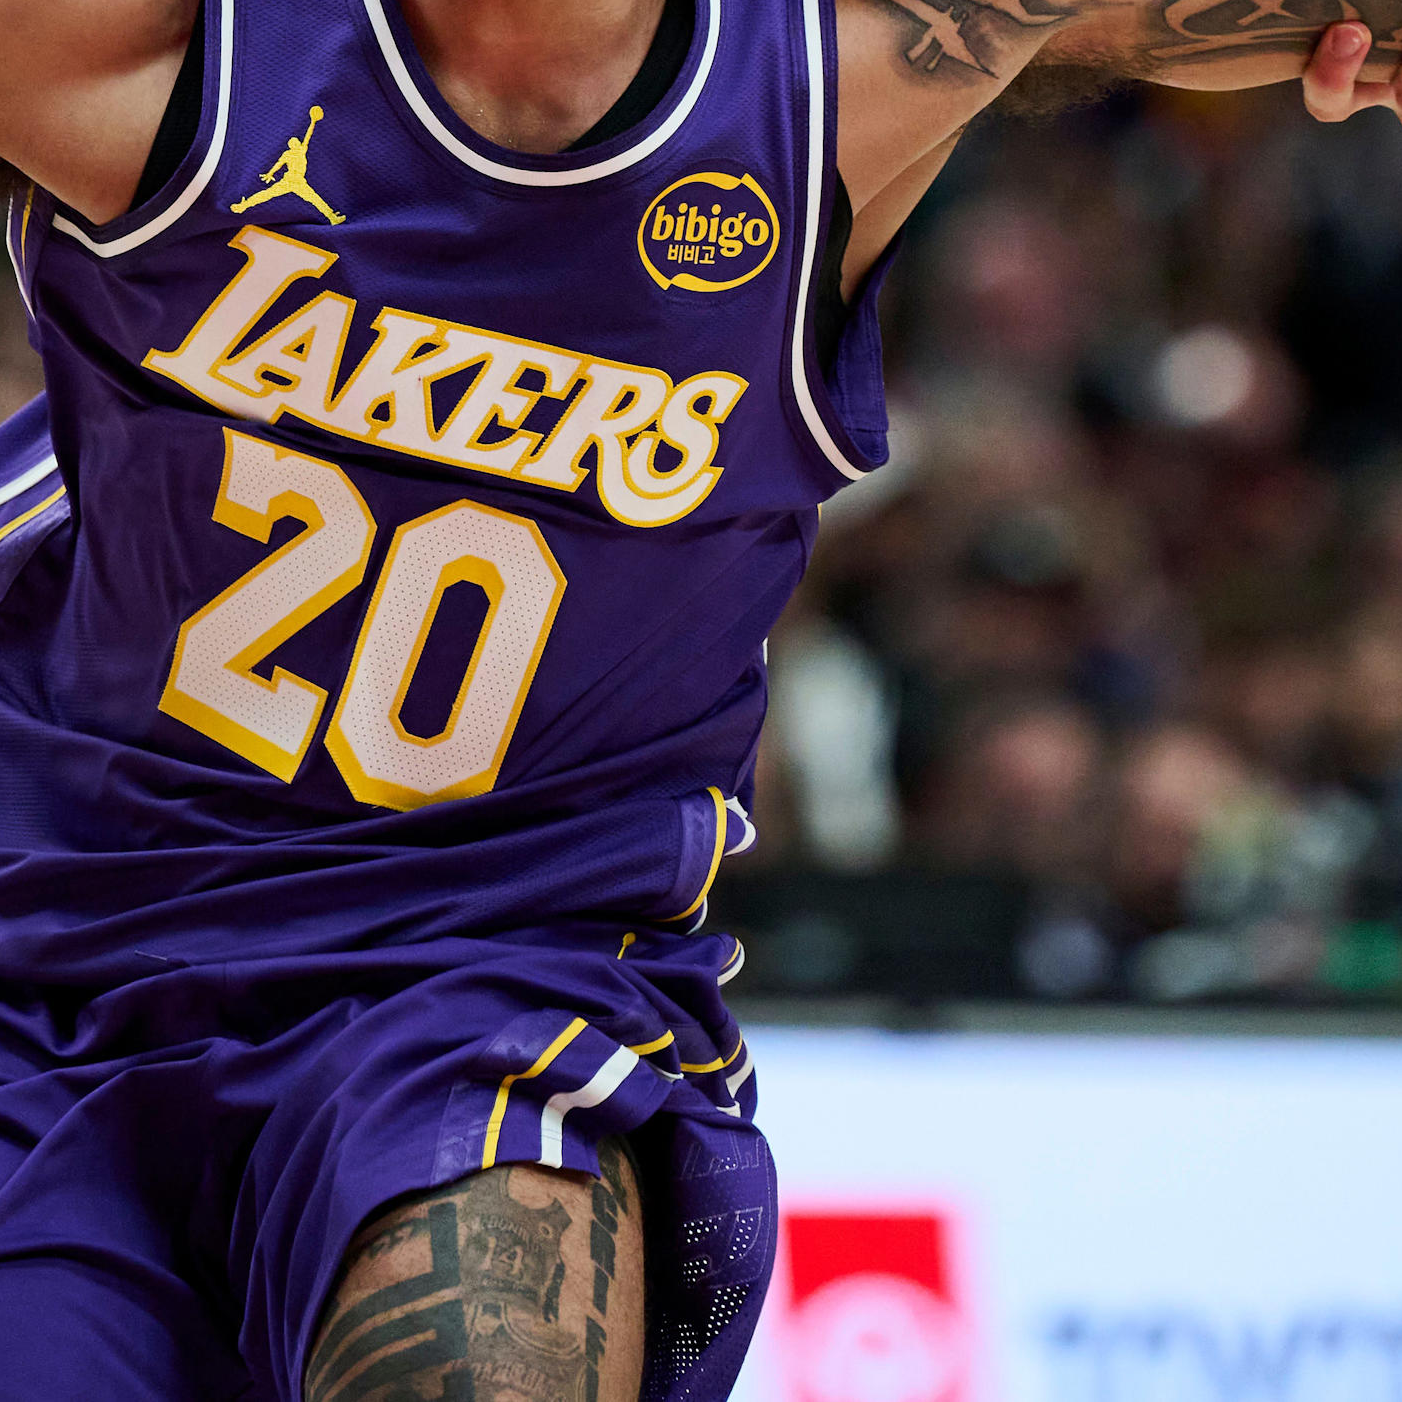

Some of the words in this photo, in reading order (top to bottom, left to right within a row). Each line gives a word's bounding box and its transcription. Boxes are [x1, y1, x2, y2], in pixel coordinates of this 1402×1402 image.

[651, 202, 770, 258] bibigo
[667, 243, 716, 265] 비비고
[141, 224, 749, 528] LAKERS
[158, 426, 568, 811] 20
